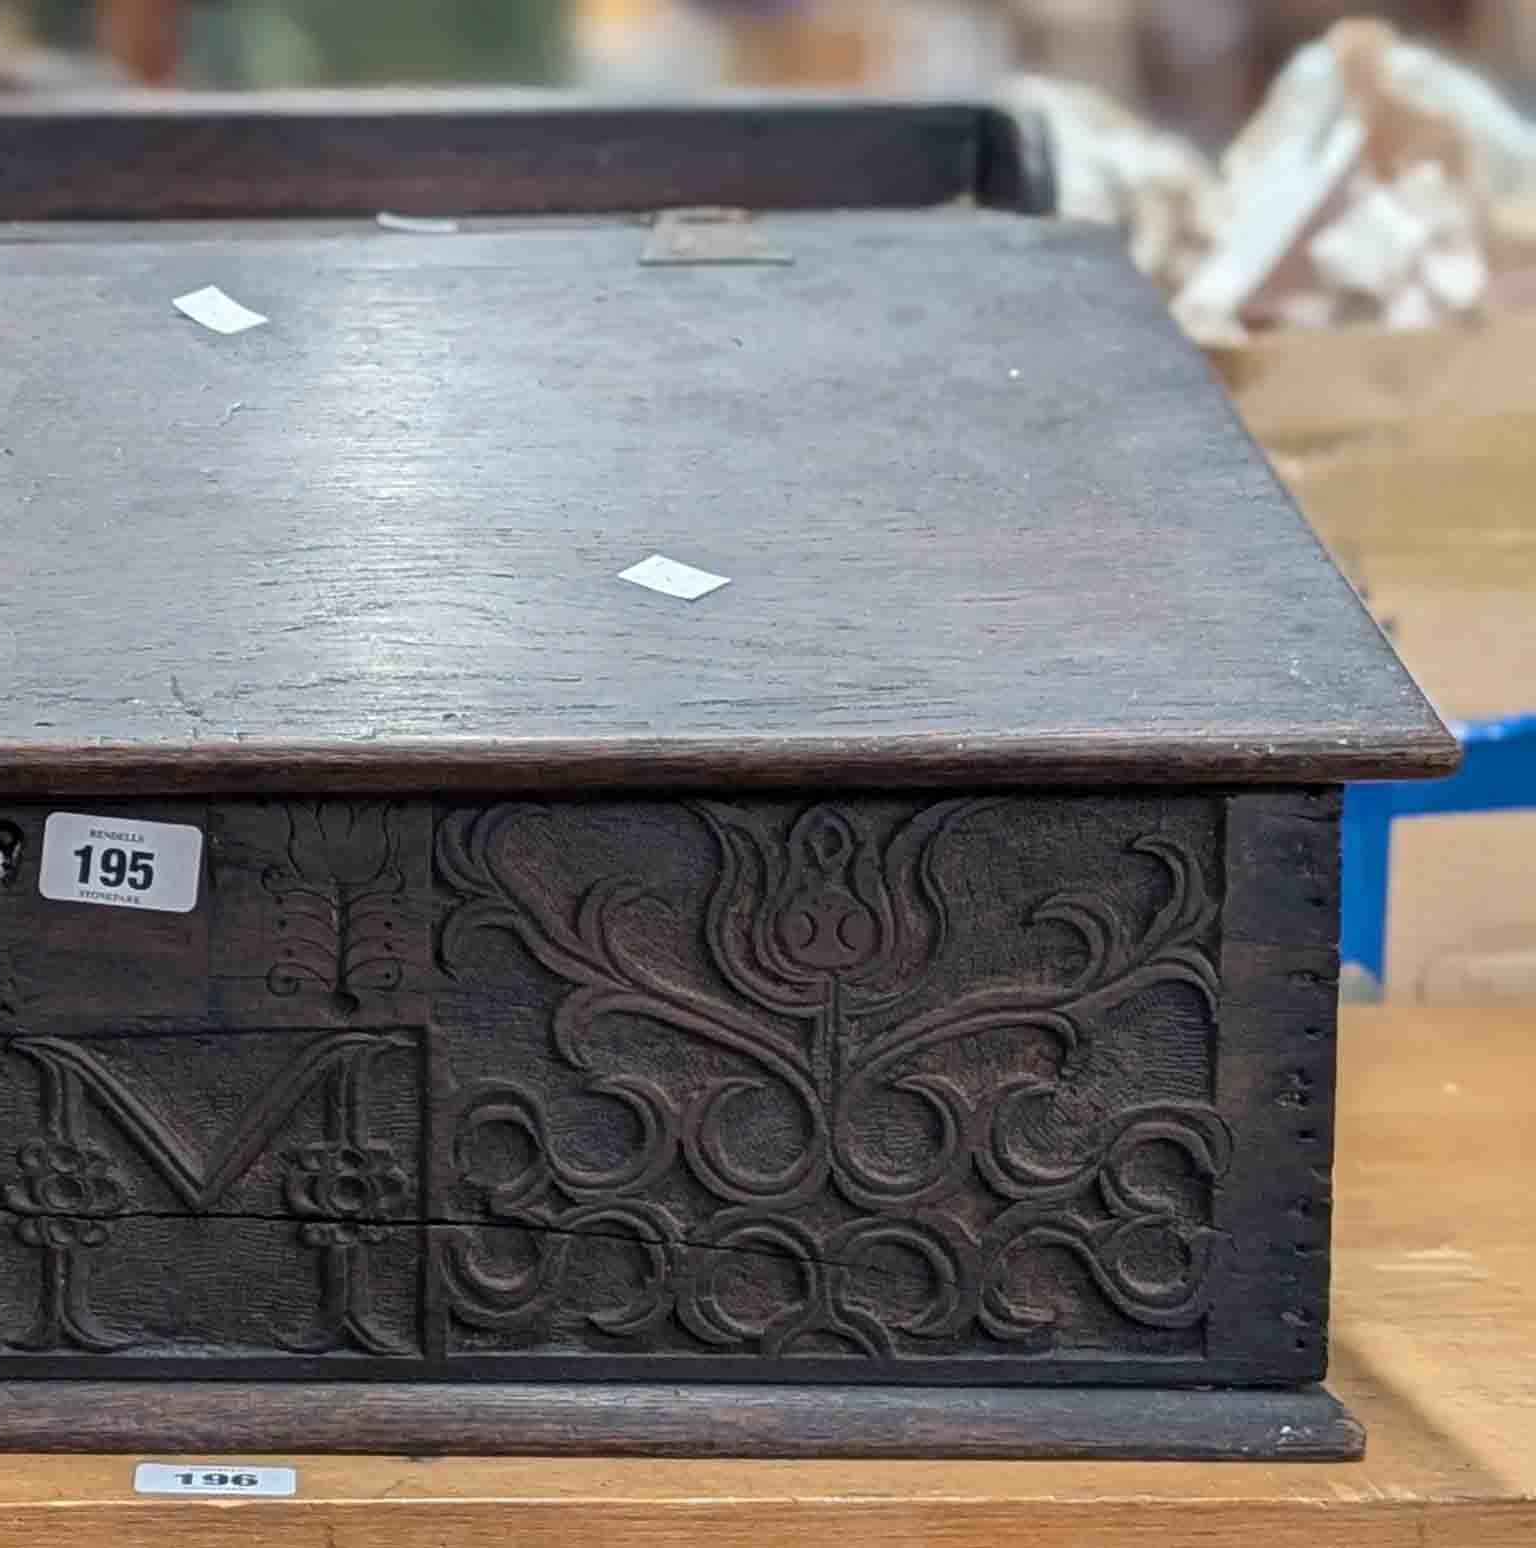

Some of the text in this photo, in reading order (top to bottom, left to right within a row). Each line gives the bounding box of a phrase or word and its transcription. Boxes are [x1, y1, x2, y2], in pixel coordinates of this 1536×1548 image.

[89, 829, 145, 842] RENDELLS
[73, 844, 155, 891] 195
[174, 1473, 258, 1486] 196
